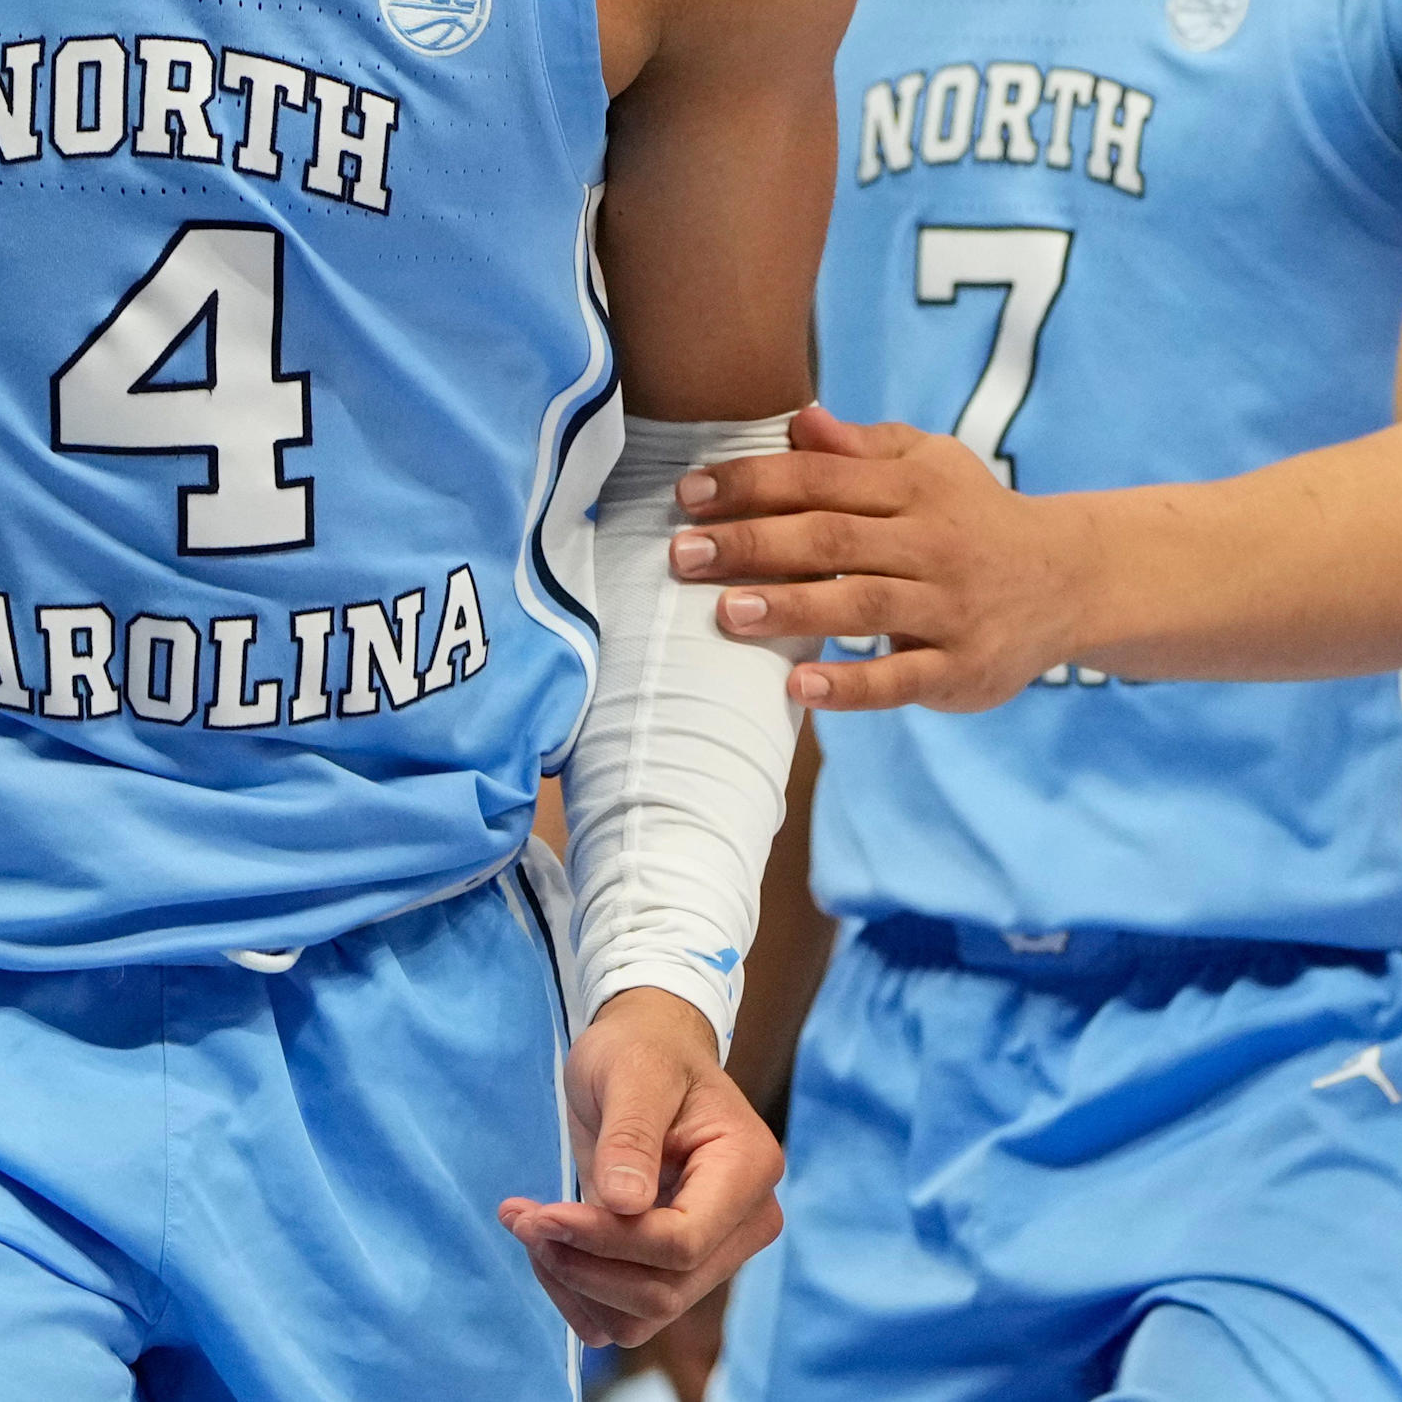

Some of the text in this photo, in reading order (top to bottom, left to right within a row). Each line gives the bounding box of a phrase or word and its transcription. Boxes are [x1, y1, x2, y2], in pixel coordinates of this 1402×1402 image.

[855, 61, 1155, 199] NORTH
[50, 219, 315, 556] 4
[914, 222, 1076, 494] 7
